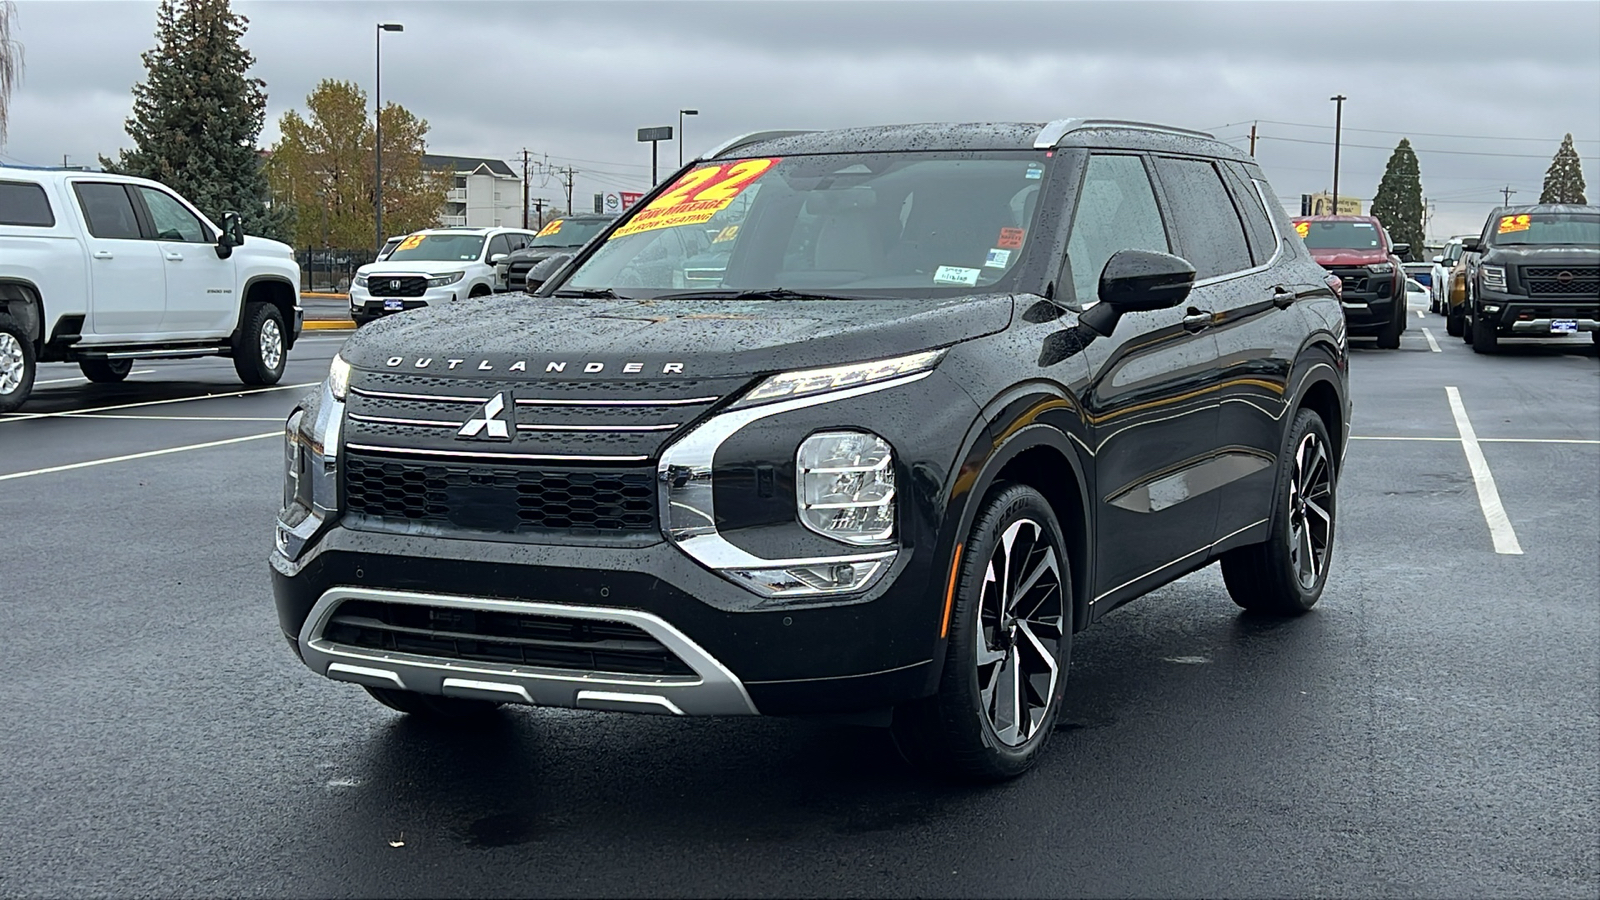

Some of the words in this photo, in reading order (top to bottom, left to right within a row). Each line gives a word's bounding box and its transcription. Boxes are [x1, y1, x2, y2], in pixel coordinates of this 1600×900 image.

[645, 159, 771, 210] 22
[632, 208, 665, 223] LOW
[663, 199, 728, 216] MILEAGE
[633, 220, 663, 231] ROW
[662, 213, 713, 226] SEATING
[386, 356, 684, 374] OUTLANDER
